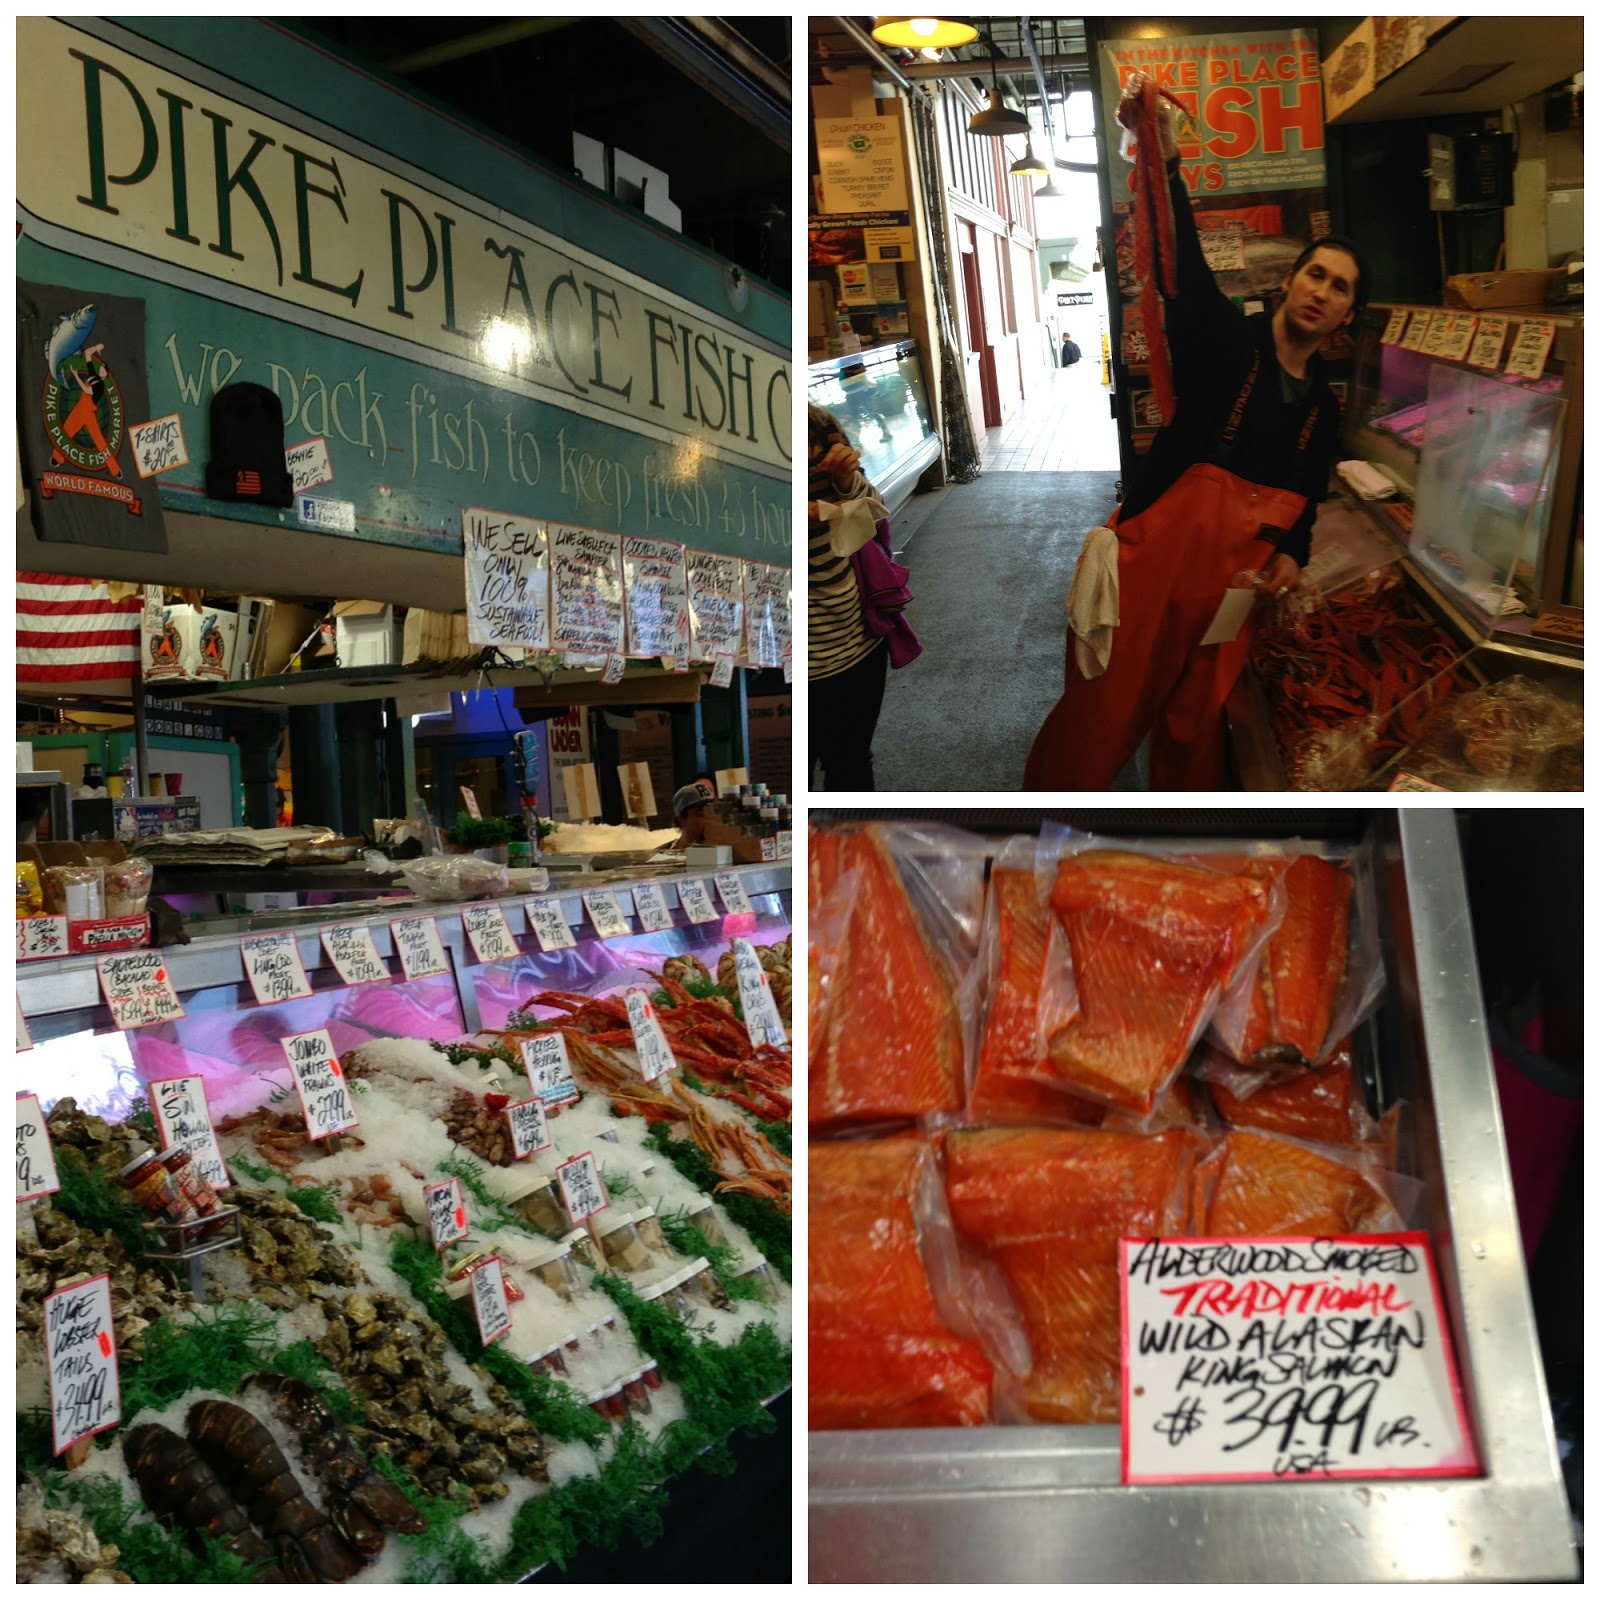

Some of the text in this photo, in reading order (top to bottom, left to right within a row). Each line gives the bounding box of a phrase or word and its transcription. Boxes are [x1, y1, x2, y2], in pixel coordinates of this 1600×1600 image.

[1117, 39, 1317, 61] IN THE KITCHEN WITH THE
[1208, 52, 1320, 85] PLACE
[1174, 81, 1325, 159] ISH
[847, 219, 868, 227] Fresh
[868, 218, 899, 226] Chicken
[69, 47, 365, 309] PIKE
[380, 188, 633, 403] PLACE
[644, 309, 758, 443] FISH
[46, 384, 121, 466] PIKE PLACE FISH MARKET
[165, 332, 242, 406] We
[406, 383, 491, 485] fish
[502, 412, 541, 486] to
[556, 427, 632, 528] keep
[642, 454, 710, 535] fresh
[44, 475, 134, 502] WORLD FAMOUS
[471, 516, 544, 557] WE SELL
[144, 694, 212, 716] LEAT
[145, 719, 222, 739] OODS.COM
[288, 1036, 327, 1061] JUMBO
[296, 1059, 330, 1078] WHITE
[1128, 1237, 1419, 1284] ALDERWOOD SMOKED
[50, 1289, 101, 1332] HUGE
[1160, 1276, 1413, 1319] TRADITIONAL
[53, 1316, 101, 1359] LOBSTER
[1139, 1310, 1425, 1357] WILD ALASKAN
[55, 1352, 94, 1383] TAILS
[1176, 1352, 1398, 1391] KING SALMON
